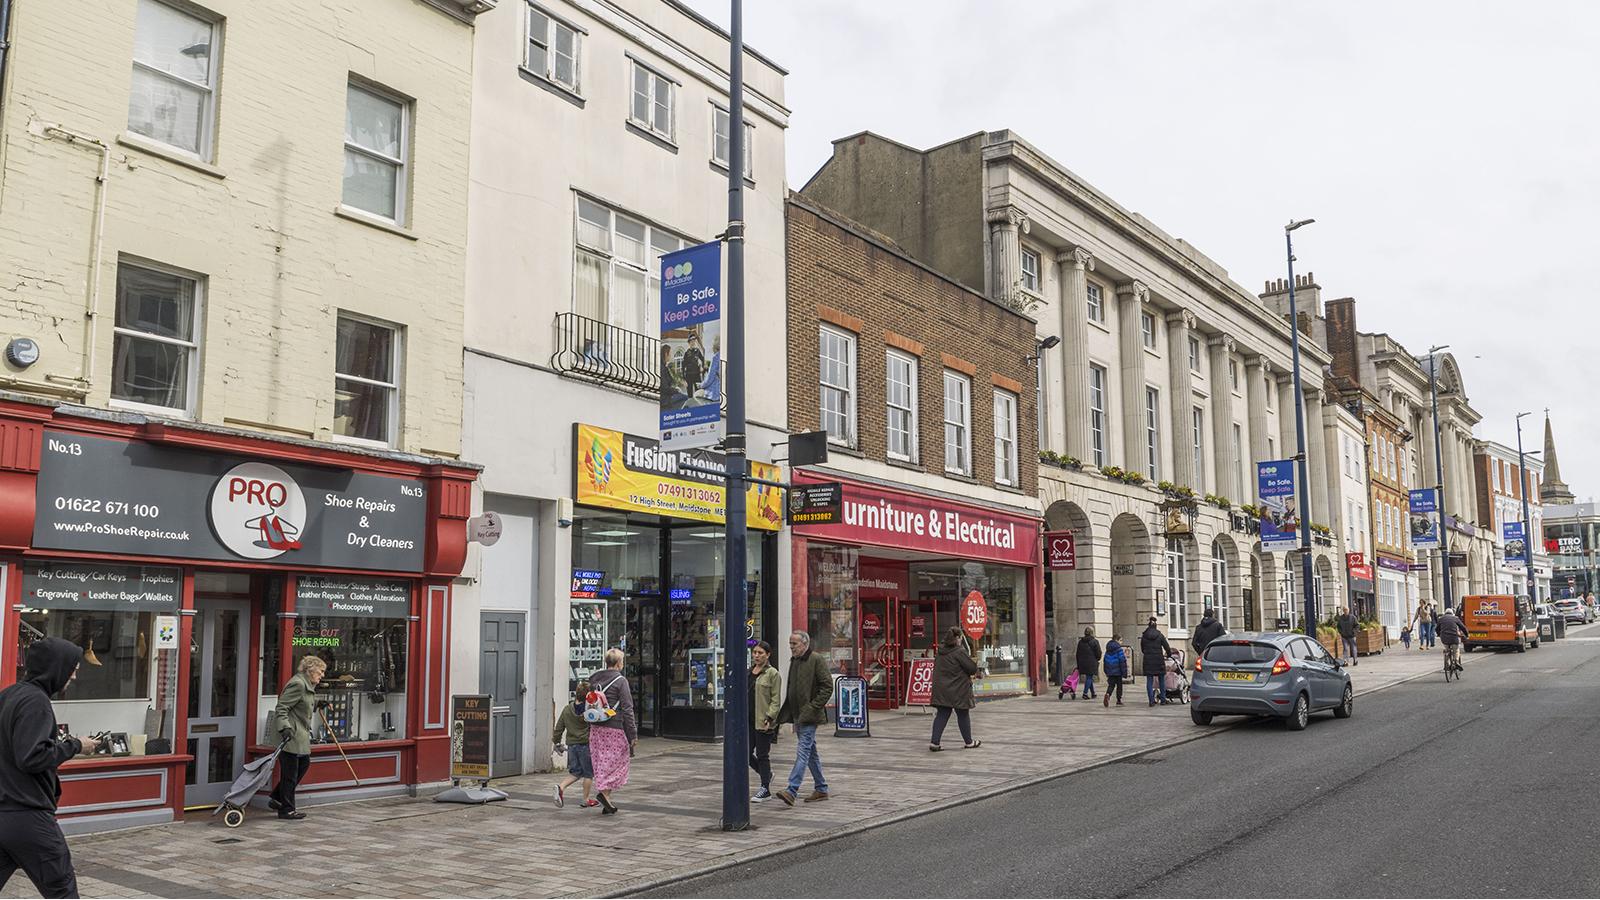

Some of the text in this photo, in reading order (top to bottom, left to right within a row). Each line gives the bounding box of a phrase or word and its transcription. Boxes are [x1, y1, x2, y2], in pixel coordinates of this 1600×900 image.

[677, 286, 718, 305] Be Safe.
[664, 302, 718, 323] Keep Safe.
[48, 439, 83, 456] No.13
[626, 440, 727, 483] Fusion Firewo
[228, 477, 288, 508] PRO
[400, 485, 423, 498] No.13
[657, 482, 721, 504] 07491313062
[54, 496, 159, 518] 01622 671 100
[324, 493, 396, 514] Shoe Repairs
[628, 494, 638, 504] 12
[639, 496, 655, 508] High
[656, 499, 676, 511] Street,
[678, 502, 711, 515] Maidstone
[358, 515, 370, 529] &
[844, 499, 1015, 549] urniture & Electrical
[53, 521, 190, 541] www.ProShoeRepair.co.uk
[347, 532, 414, 550] Dry Cleaners
[1559, 545, 1581, 553] BANK
[38, 570, 52, 580] Key
[107, 573, 126, 583] Keys
[141, 574, 174, 585] Trophies
[36, 589, 79, 601] Engraving
[88, 590, 119, 600] Leather
[297, 590, 345, 601] Leather Repairs
[349, 592, 372, 602] Clothes
[332, 601, 374, 613] Photocopying
[320, 628, 340, 638] CUT
[312, 637, 340, 647] REPAIR
[914, 667, 933, 682] 50
[465, 699, 480, 708] KEY
[456, 711, 487, 720] CUTTING
